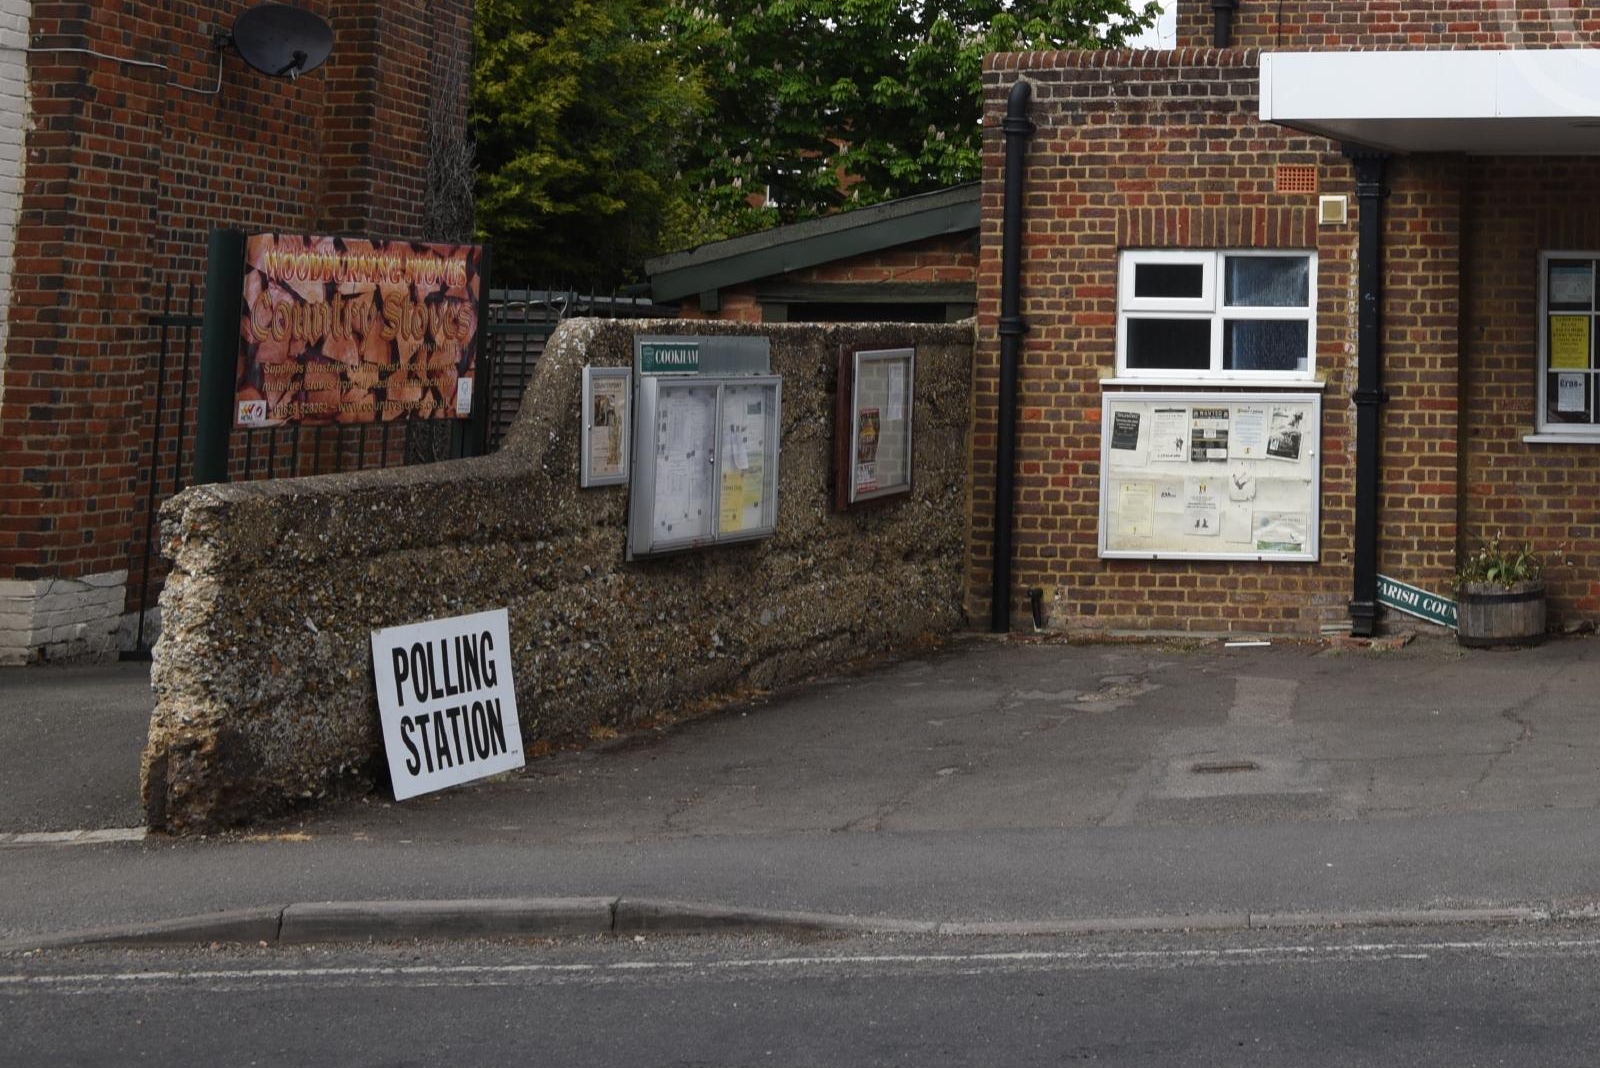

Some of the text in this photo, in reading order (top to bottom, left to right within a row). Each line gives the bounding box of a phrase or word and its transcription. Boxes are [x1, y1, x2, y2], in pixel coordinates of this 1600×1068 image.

[264, 249, 467, 287] WOODBURNING STOVES
[250, 289, 476, 356] Country Stoves
[264, 362, 304, 376] Suppliers
[655, 348, 699, 365] COOKHAM
[391, 630, 499, 707] POLLING
[400, 698, 508, 777] STATION
